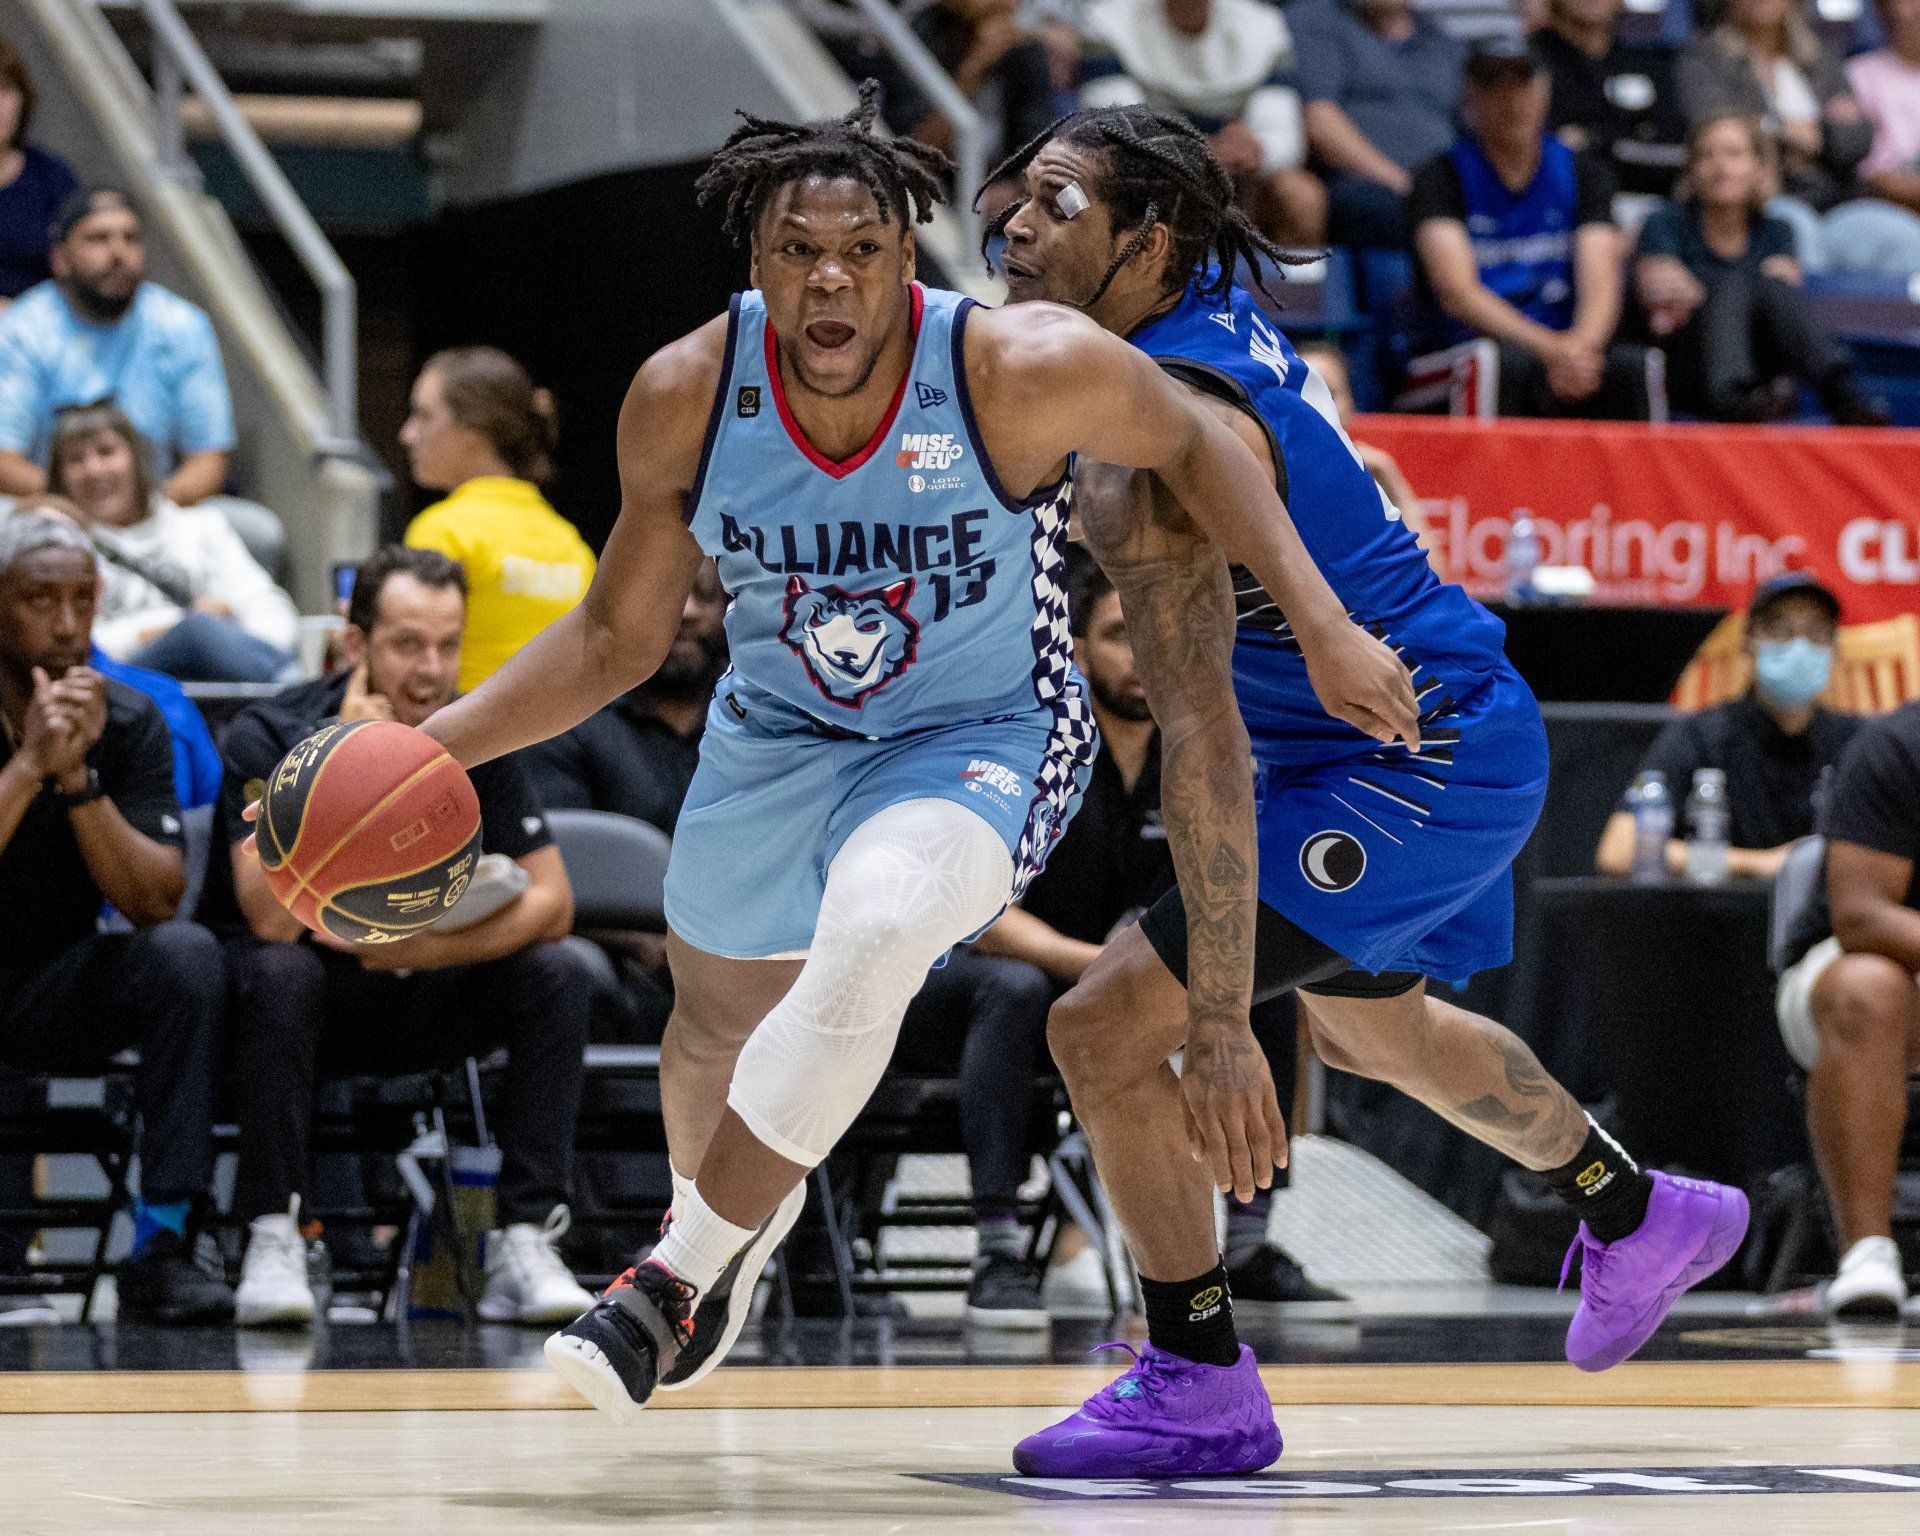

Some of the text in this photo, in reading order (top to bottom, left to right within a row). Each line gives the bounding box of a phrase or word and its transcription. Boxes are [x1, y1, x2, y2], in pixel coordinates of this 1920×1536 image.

[901, 433, 954, 452] MISE
[932, 476, 960, 484] LOTO
[719, 508, 990, 576] ALLIANCE
[966, 759, 1020, 783] MISE
